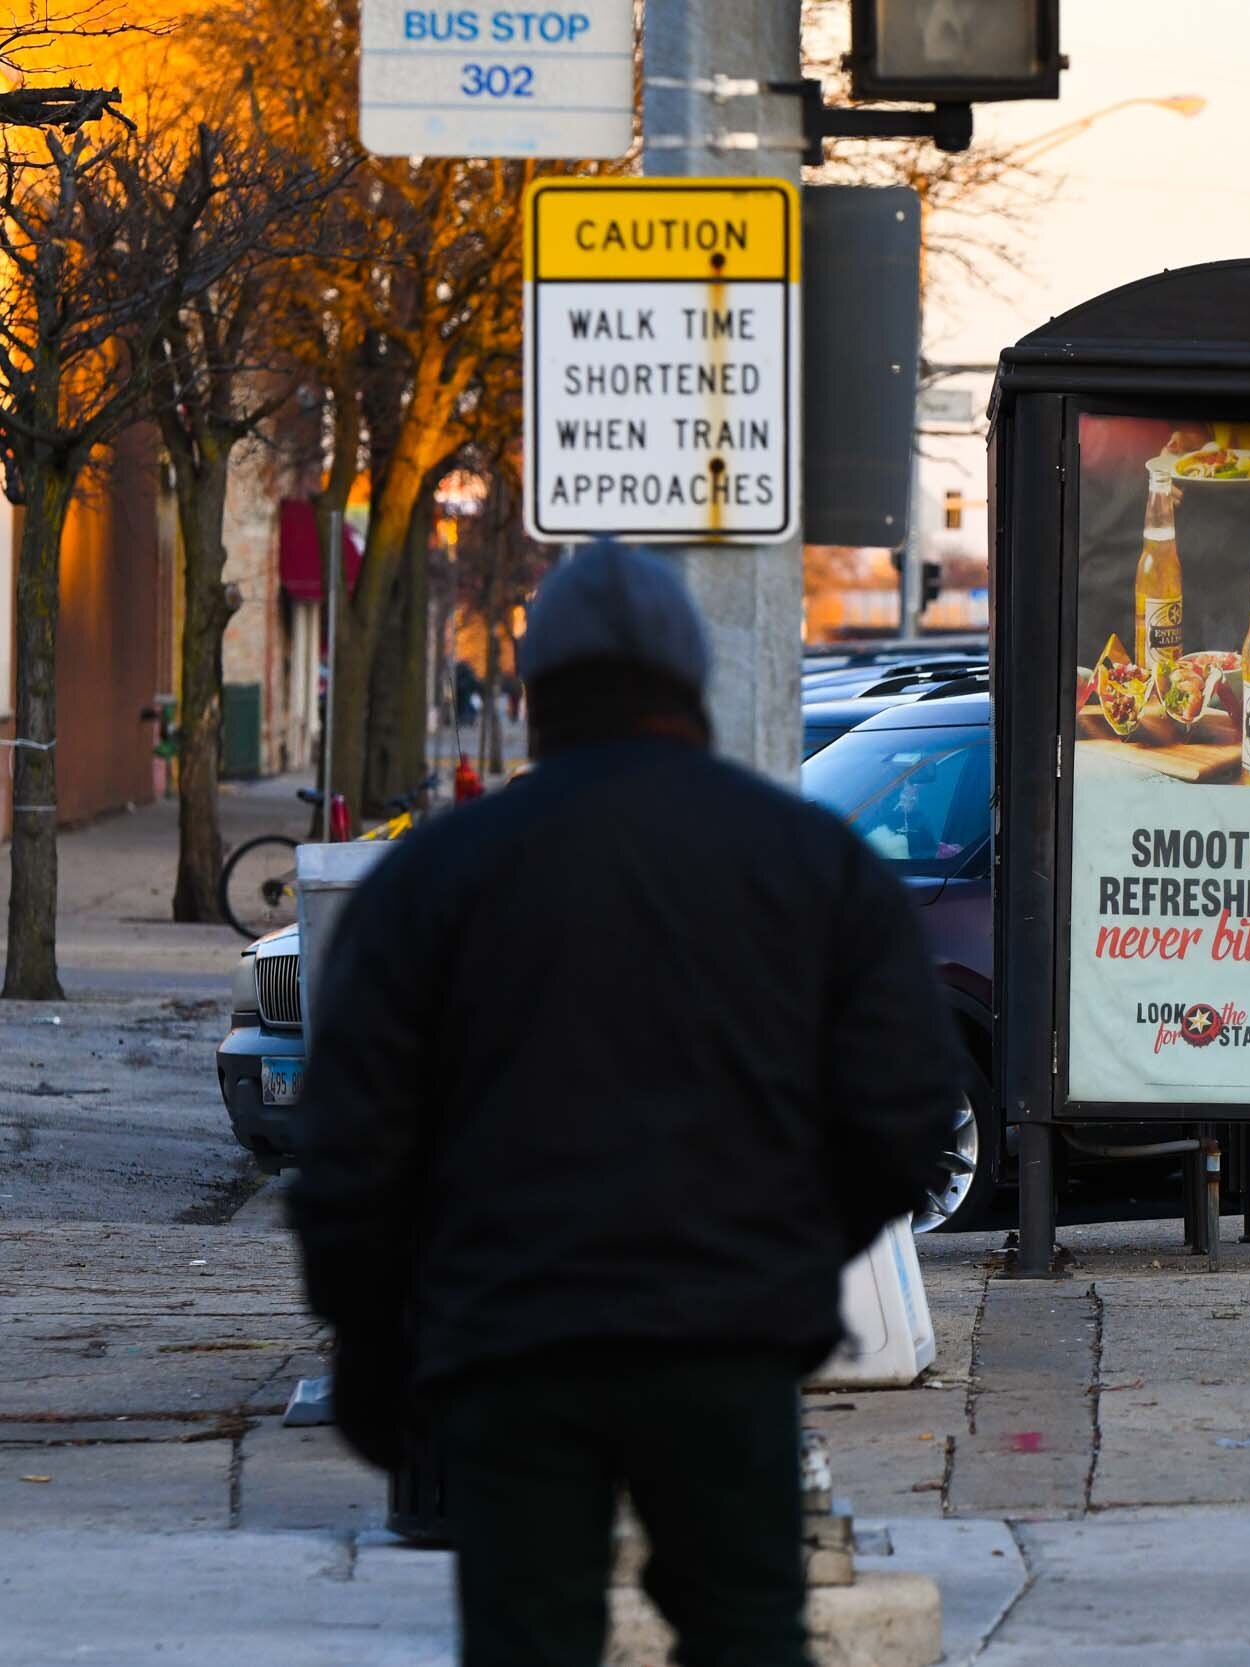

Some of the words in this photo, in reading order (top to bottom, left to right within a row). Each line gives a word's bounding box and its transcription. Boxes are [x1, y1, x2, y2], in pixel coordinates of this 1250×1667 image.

[404, 10, 480, 41] BUS
[491, 10, 590, 43] STOP
[460, 63, 534, 97] 302
[575, 219, 748, 252] CAUTION
[568, 308, 656, 340] WALK
[682, 308, 756, 340] TIME
[565, 364, 761, 396] SHORTENED
[556, 419, 647, 450] WHEN
[672, 419, 769, 450] TRAIN
[551, 474, 774, 506] APPROACHES
[1095, 921, 1203, 960] never
[1136, 1002, 1186, 1024] LOOK
[1220, 1001, 1248, 1025] the
[1153, 1021, 1183, 1055] for
